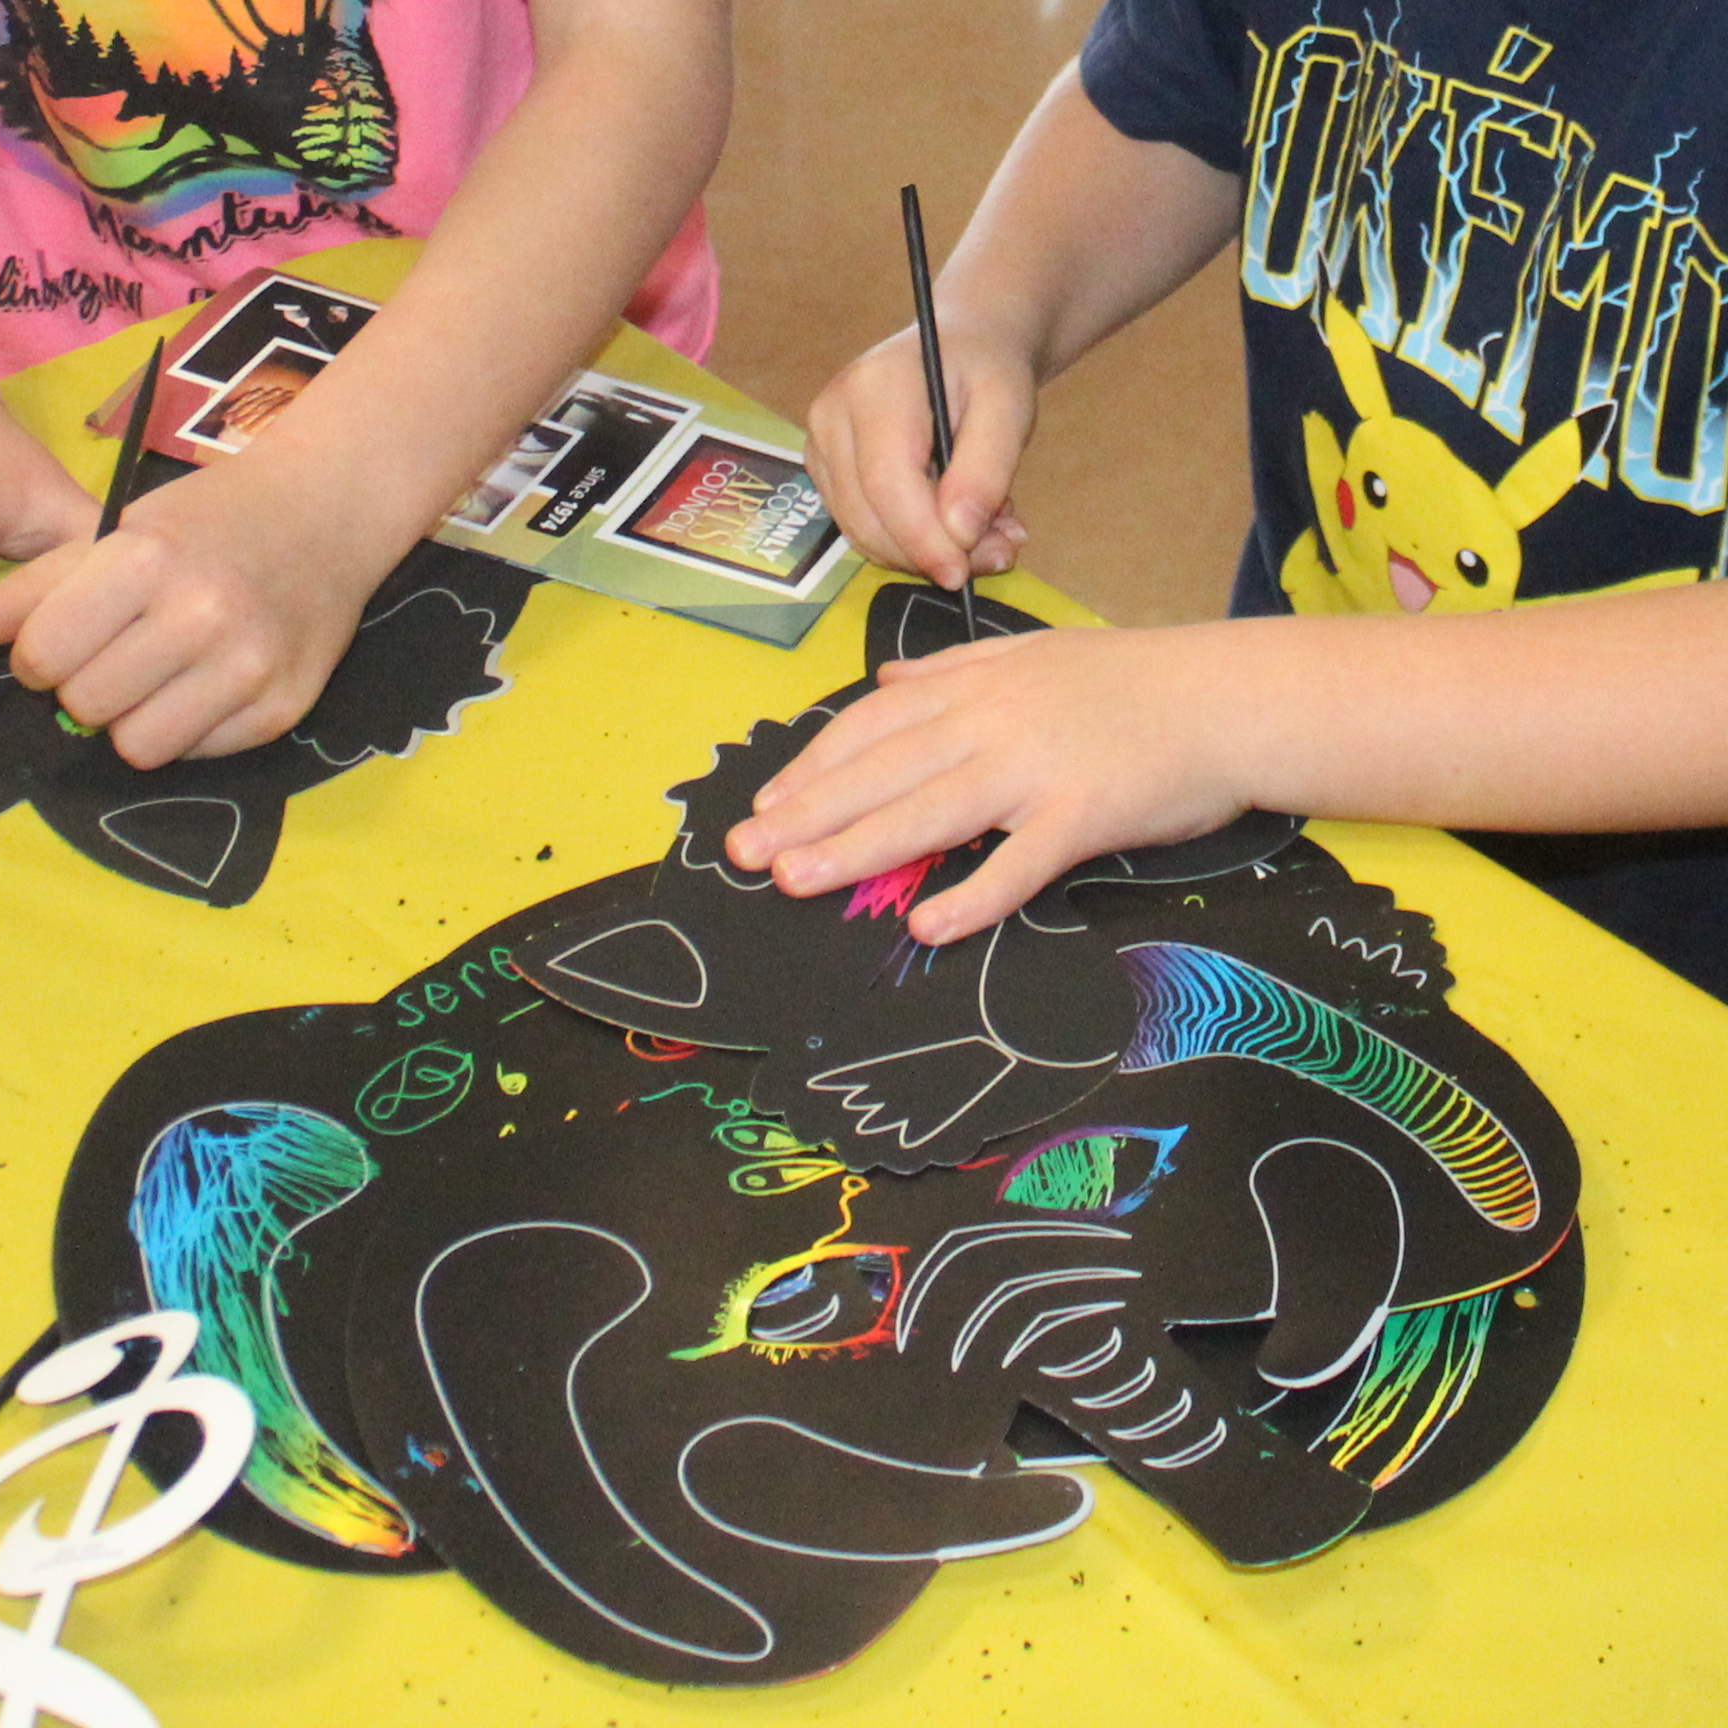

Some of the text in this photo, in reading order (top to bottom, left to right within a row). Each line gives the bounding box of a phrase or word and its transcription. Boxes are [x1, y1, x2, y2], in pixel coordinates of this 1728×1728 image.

[539, 466, 606, 531] since 1974
[657, 460, 737, 534] COUNCIL
[687, 467, 775, 546] ARTS
[731, 482, 802, 556] COUNTY
[756, 489, 822, 562] STANLY
